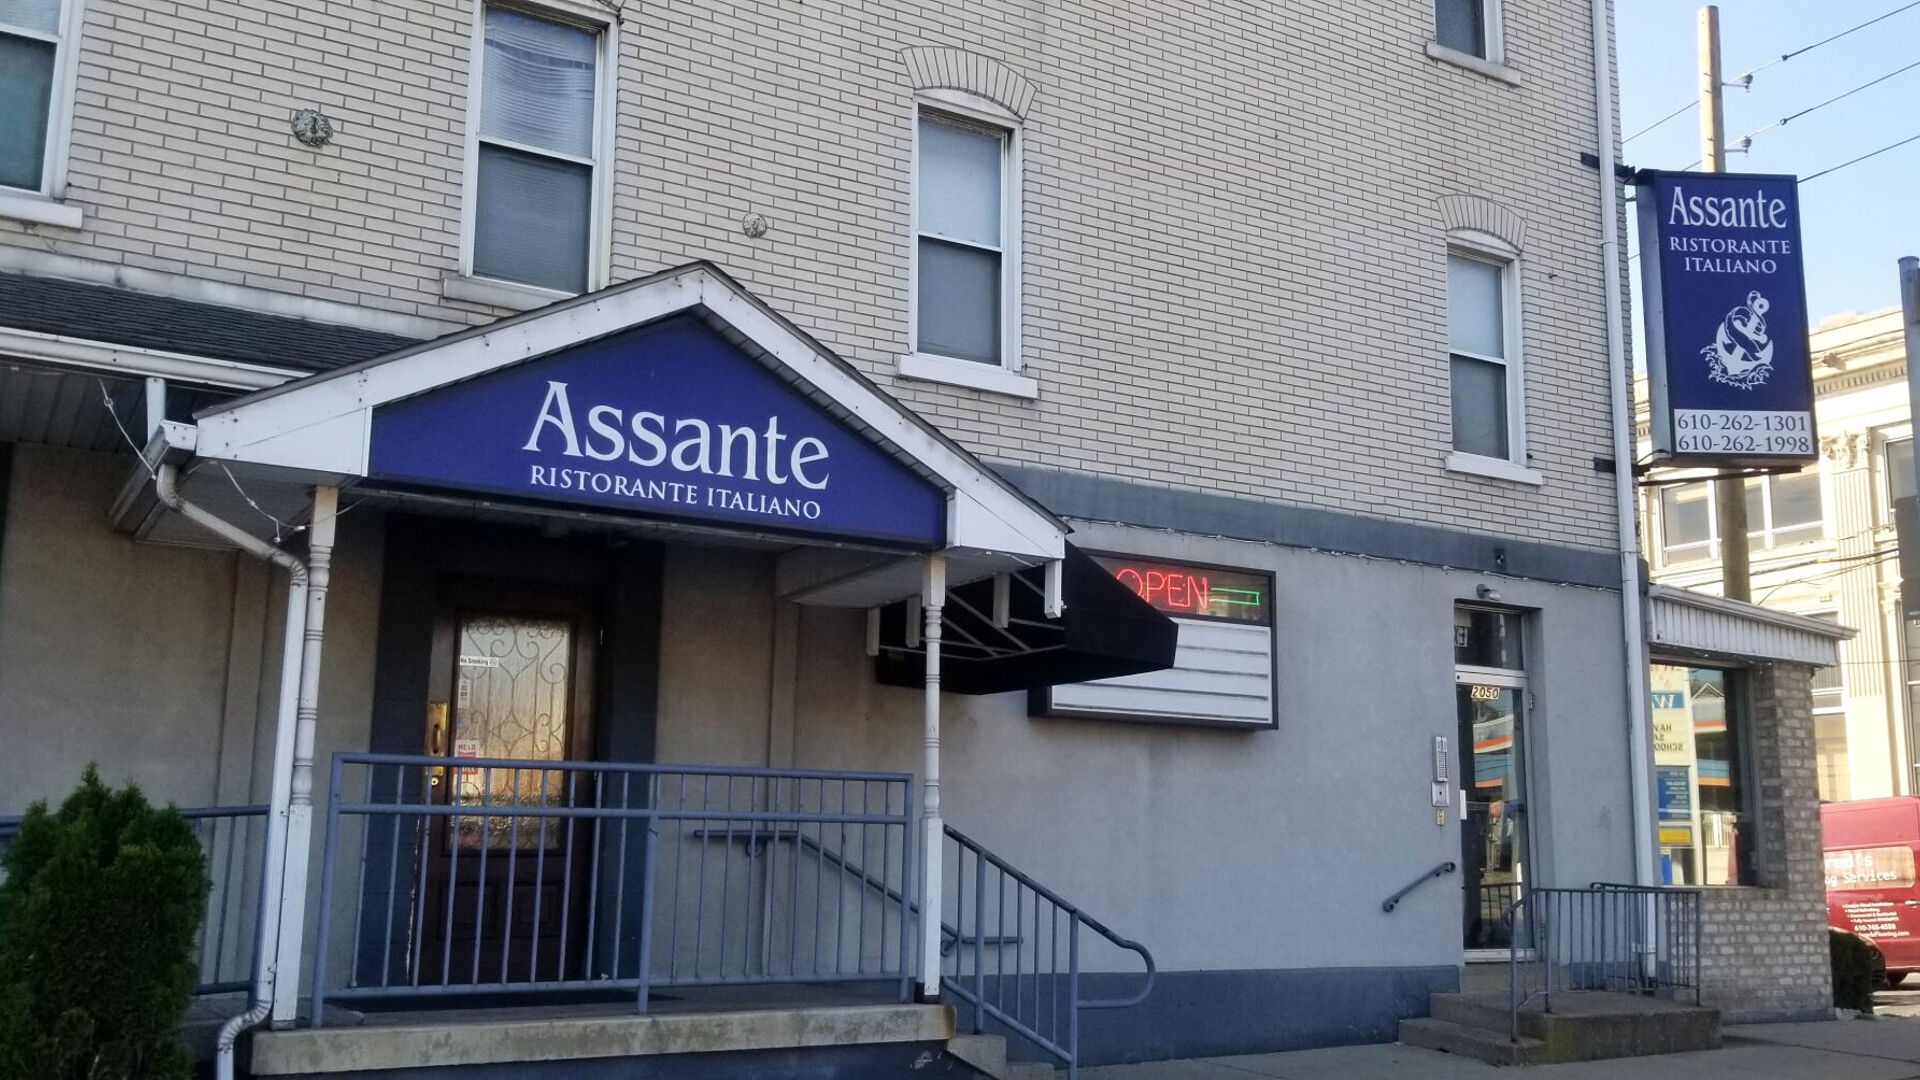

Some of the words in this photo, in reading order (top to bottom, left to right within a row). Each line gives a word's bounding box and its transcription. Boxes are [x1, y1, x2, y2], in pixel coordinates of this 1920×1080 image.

[1669, 186, 1787, 228] Assante
[1670, 236, 1791, 254] RISTORANTE
[1685, 257, 1777, 274] ITALIANO
[1677, 413, 1807, 432] 610-262-1301
[521, 380, 830, 490] Assante
[1678, 434, 1809, 452] 610-262-1998
[530, 465, 698, 505] RISTORANTE
[707, 487, 821, 520] ITALIANO
[1116, 568, 1208, 609] OPEN
[1472, 686, 1499, 699] 2050
[1843, 869, 1897, 883] Services
